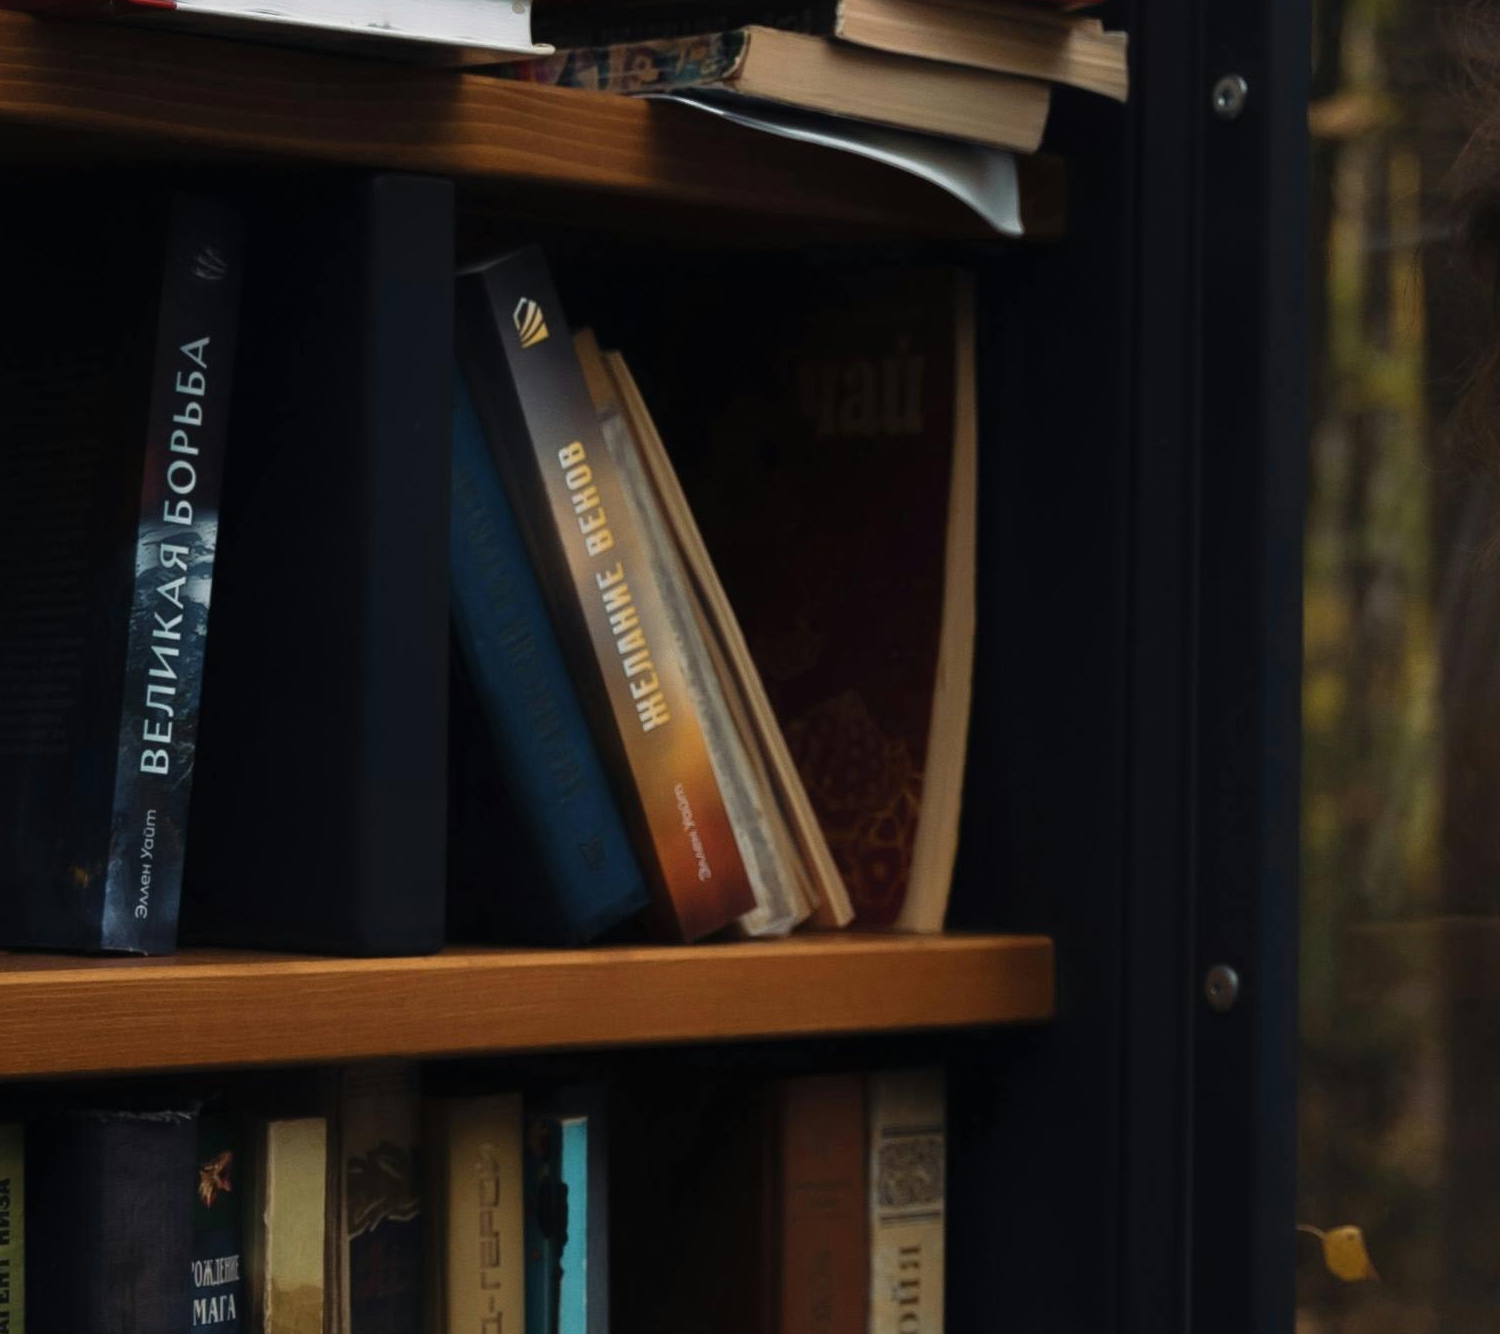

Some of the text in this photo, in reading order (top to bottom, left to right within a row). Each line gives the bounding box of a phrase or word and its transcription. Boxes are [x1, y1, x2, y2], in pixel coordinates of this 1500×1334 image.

[139, 334, 213, 775] ВЕЛИКАЯ БОРЬБА
[557, 440, 672, 734] ЖЕЛАНИЕ ВЕКОВ
[135, 808, 158, 920] Эллен Уайт
[192, 1293, 236, 1326] МАГА
